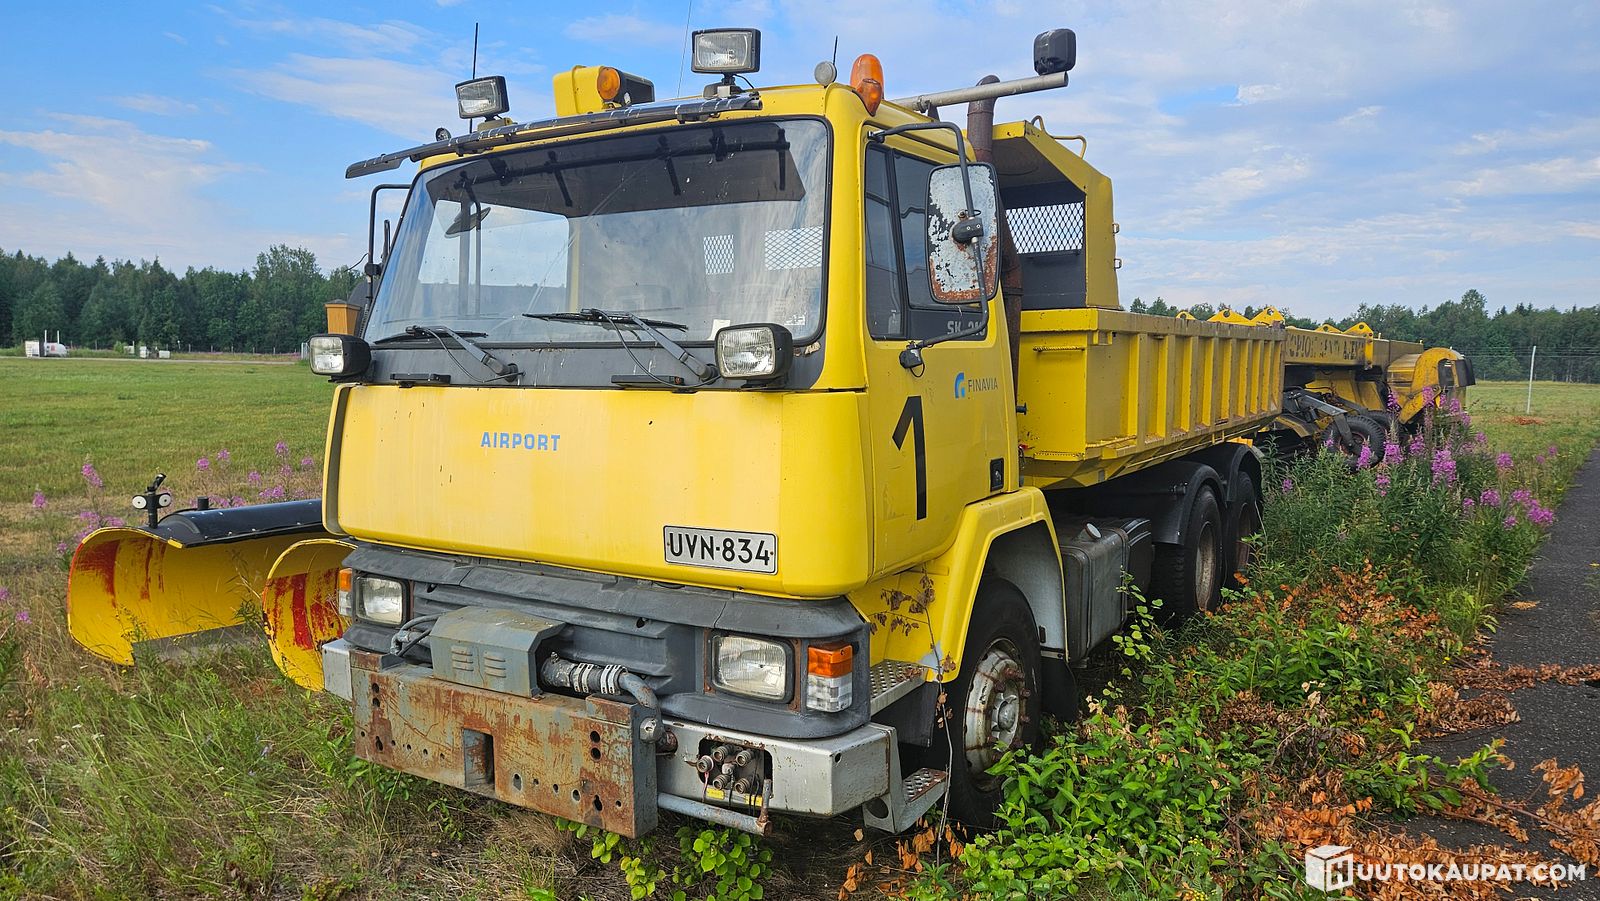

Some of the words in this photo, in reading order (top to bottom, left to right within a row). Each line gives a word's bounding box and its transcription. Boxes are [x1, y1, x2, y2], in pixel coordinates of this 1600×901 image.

[967, 377, 998, 393] FINAVIA
[480, 431, 560, 451] AIRPORT
[892, 396, 927, 520] 1
[669, 532, 770, 566] UVN-834
